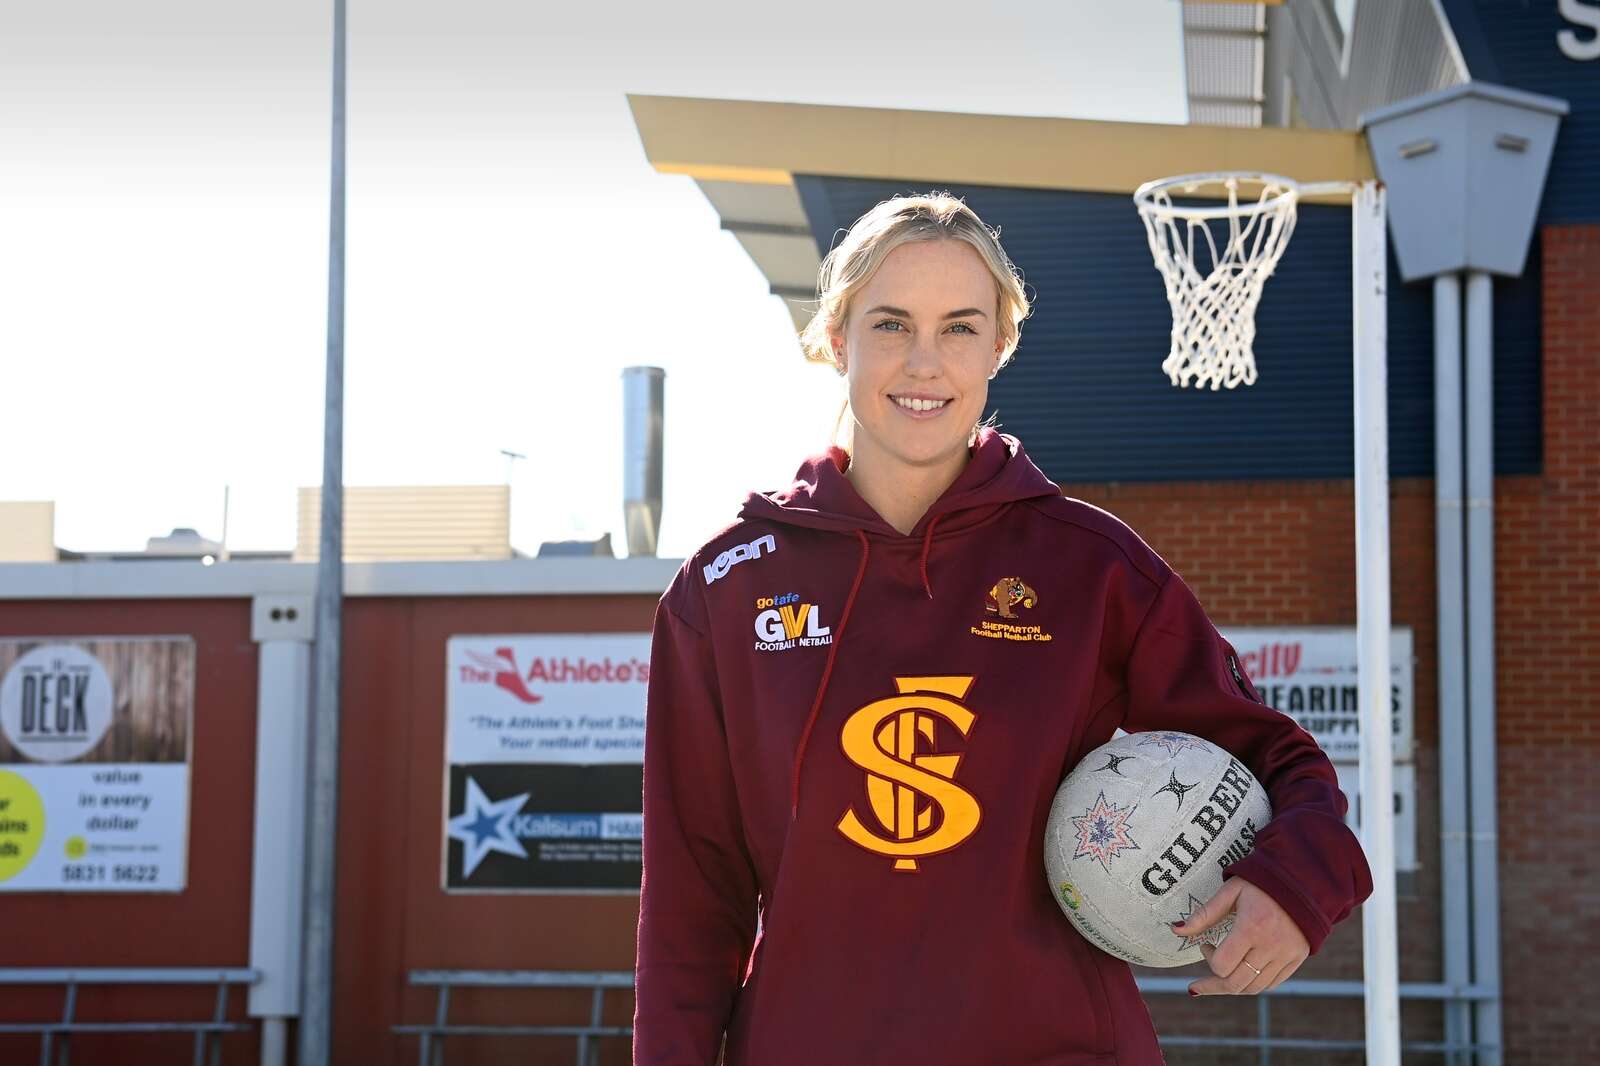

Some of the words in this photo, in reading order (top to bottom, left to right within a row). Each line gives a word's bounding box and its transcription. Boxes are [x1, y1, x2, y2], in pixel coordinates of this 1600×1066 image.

[756, 592, 800, 609] gotafe
[755, 604, 830, 642] GVL
[982, 621, 1041, 634] SHEPPARTON
[970, 627, 1002, 638] Football
[1003, 631, 1032, 641] Netball
[1033, 633, 1052, 641] Club
[755, 639, 796, 651] FOOTBALL
[799, 635, 833, 647] NETBALL
[459, 665, 492, 682] The
[527, 655, 649, 683] Athlete's
[21, 674, 90, 734] DECK
[499, 736, 534, 749] Your
[538, 735, 590, 749] netball
[92, 771, 142, 784] value
[78, 793, 97, 807] in
[100, 795, 152, 811] every
[85, 816, 139, 830] dollar
[1141, 758, 1253, 896] GILBERT
